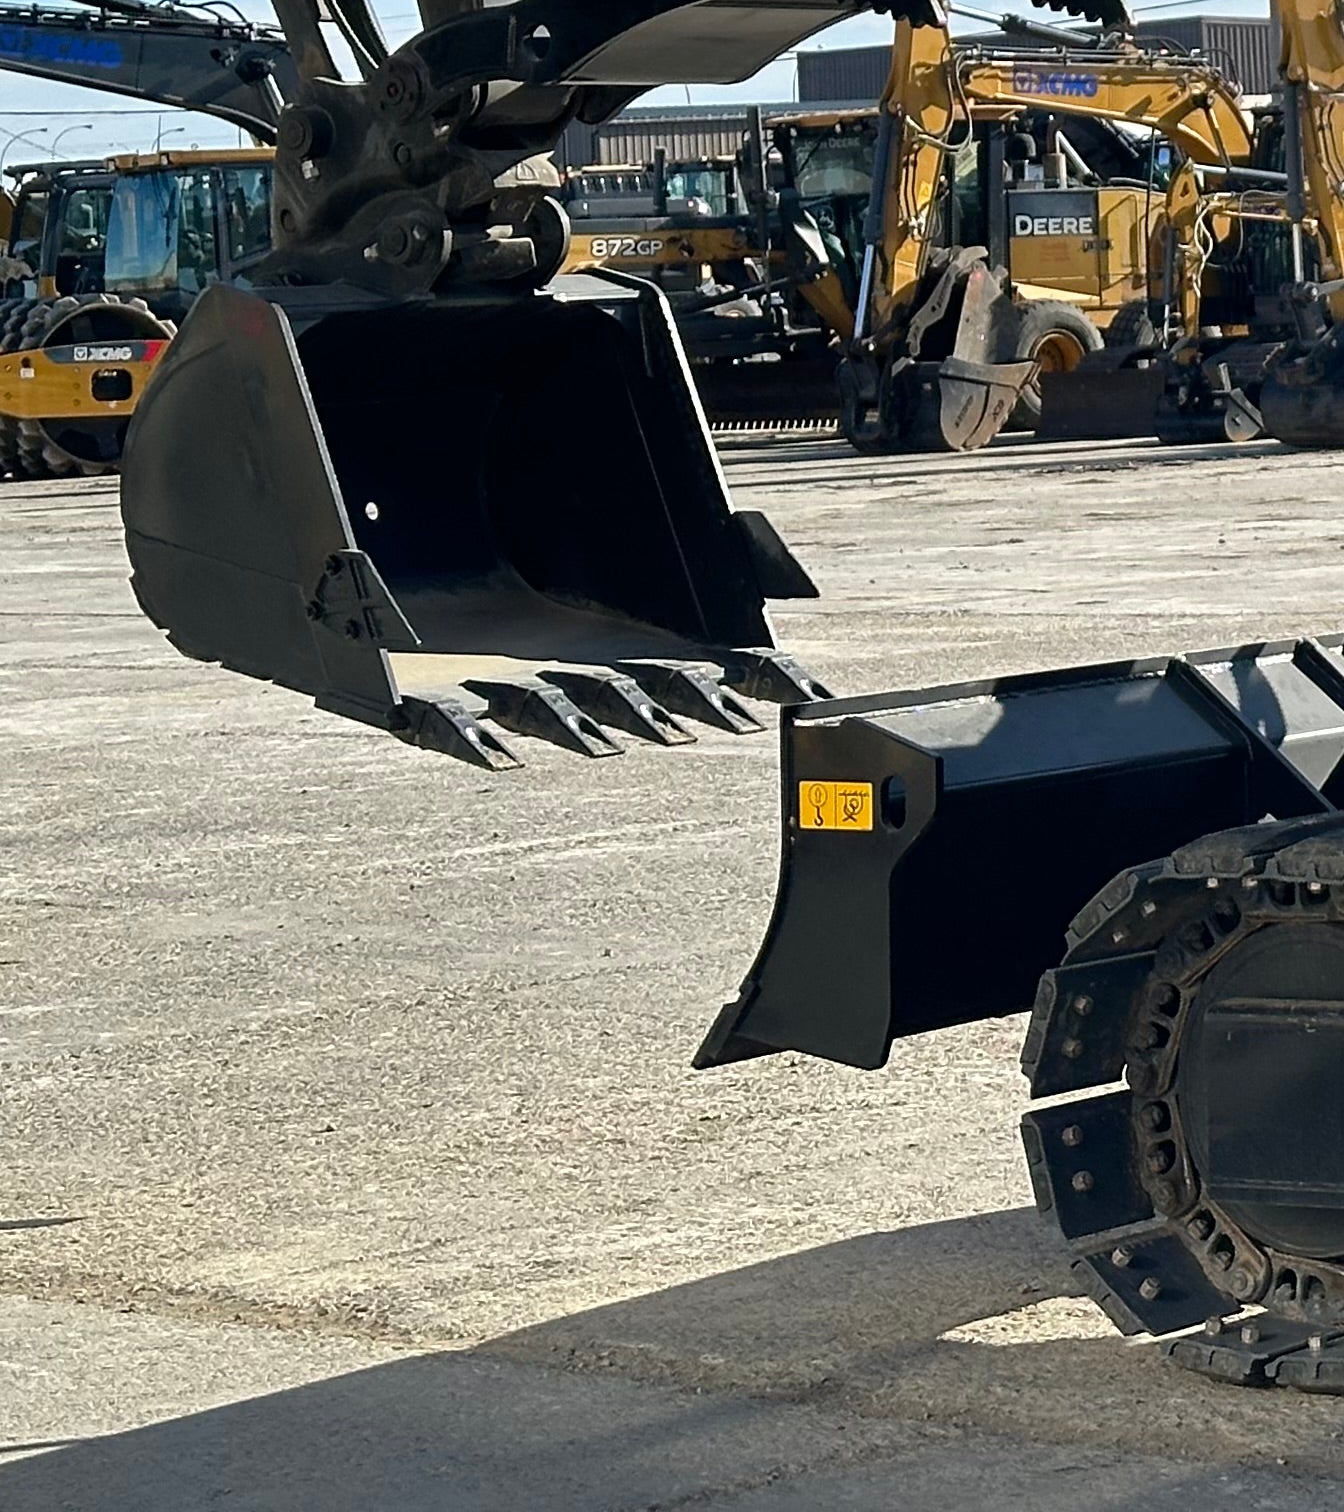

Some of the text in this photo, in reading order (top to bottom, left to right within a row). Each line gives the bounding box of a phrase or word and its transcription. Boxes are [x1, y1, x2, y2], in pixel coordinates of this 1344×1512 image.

[1014, 214, 1094, 236] DEERE
[591, 238, 664, 257] 872GP
[88, 346, 133, 361] XCMG
